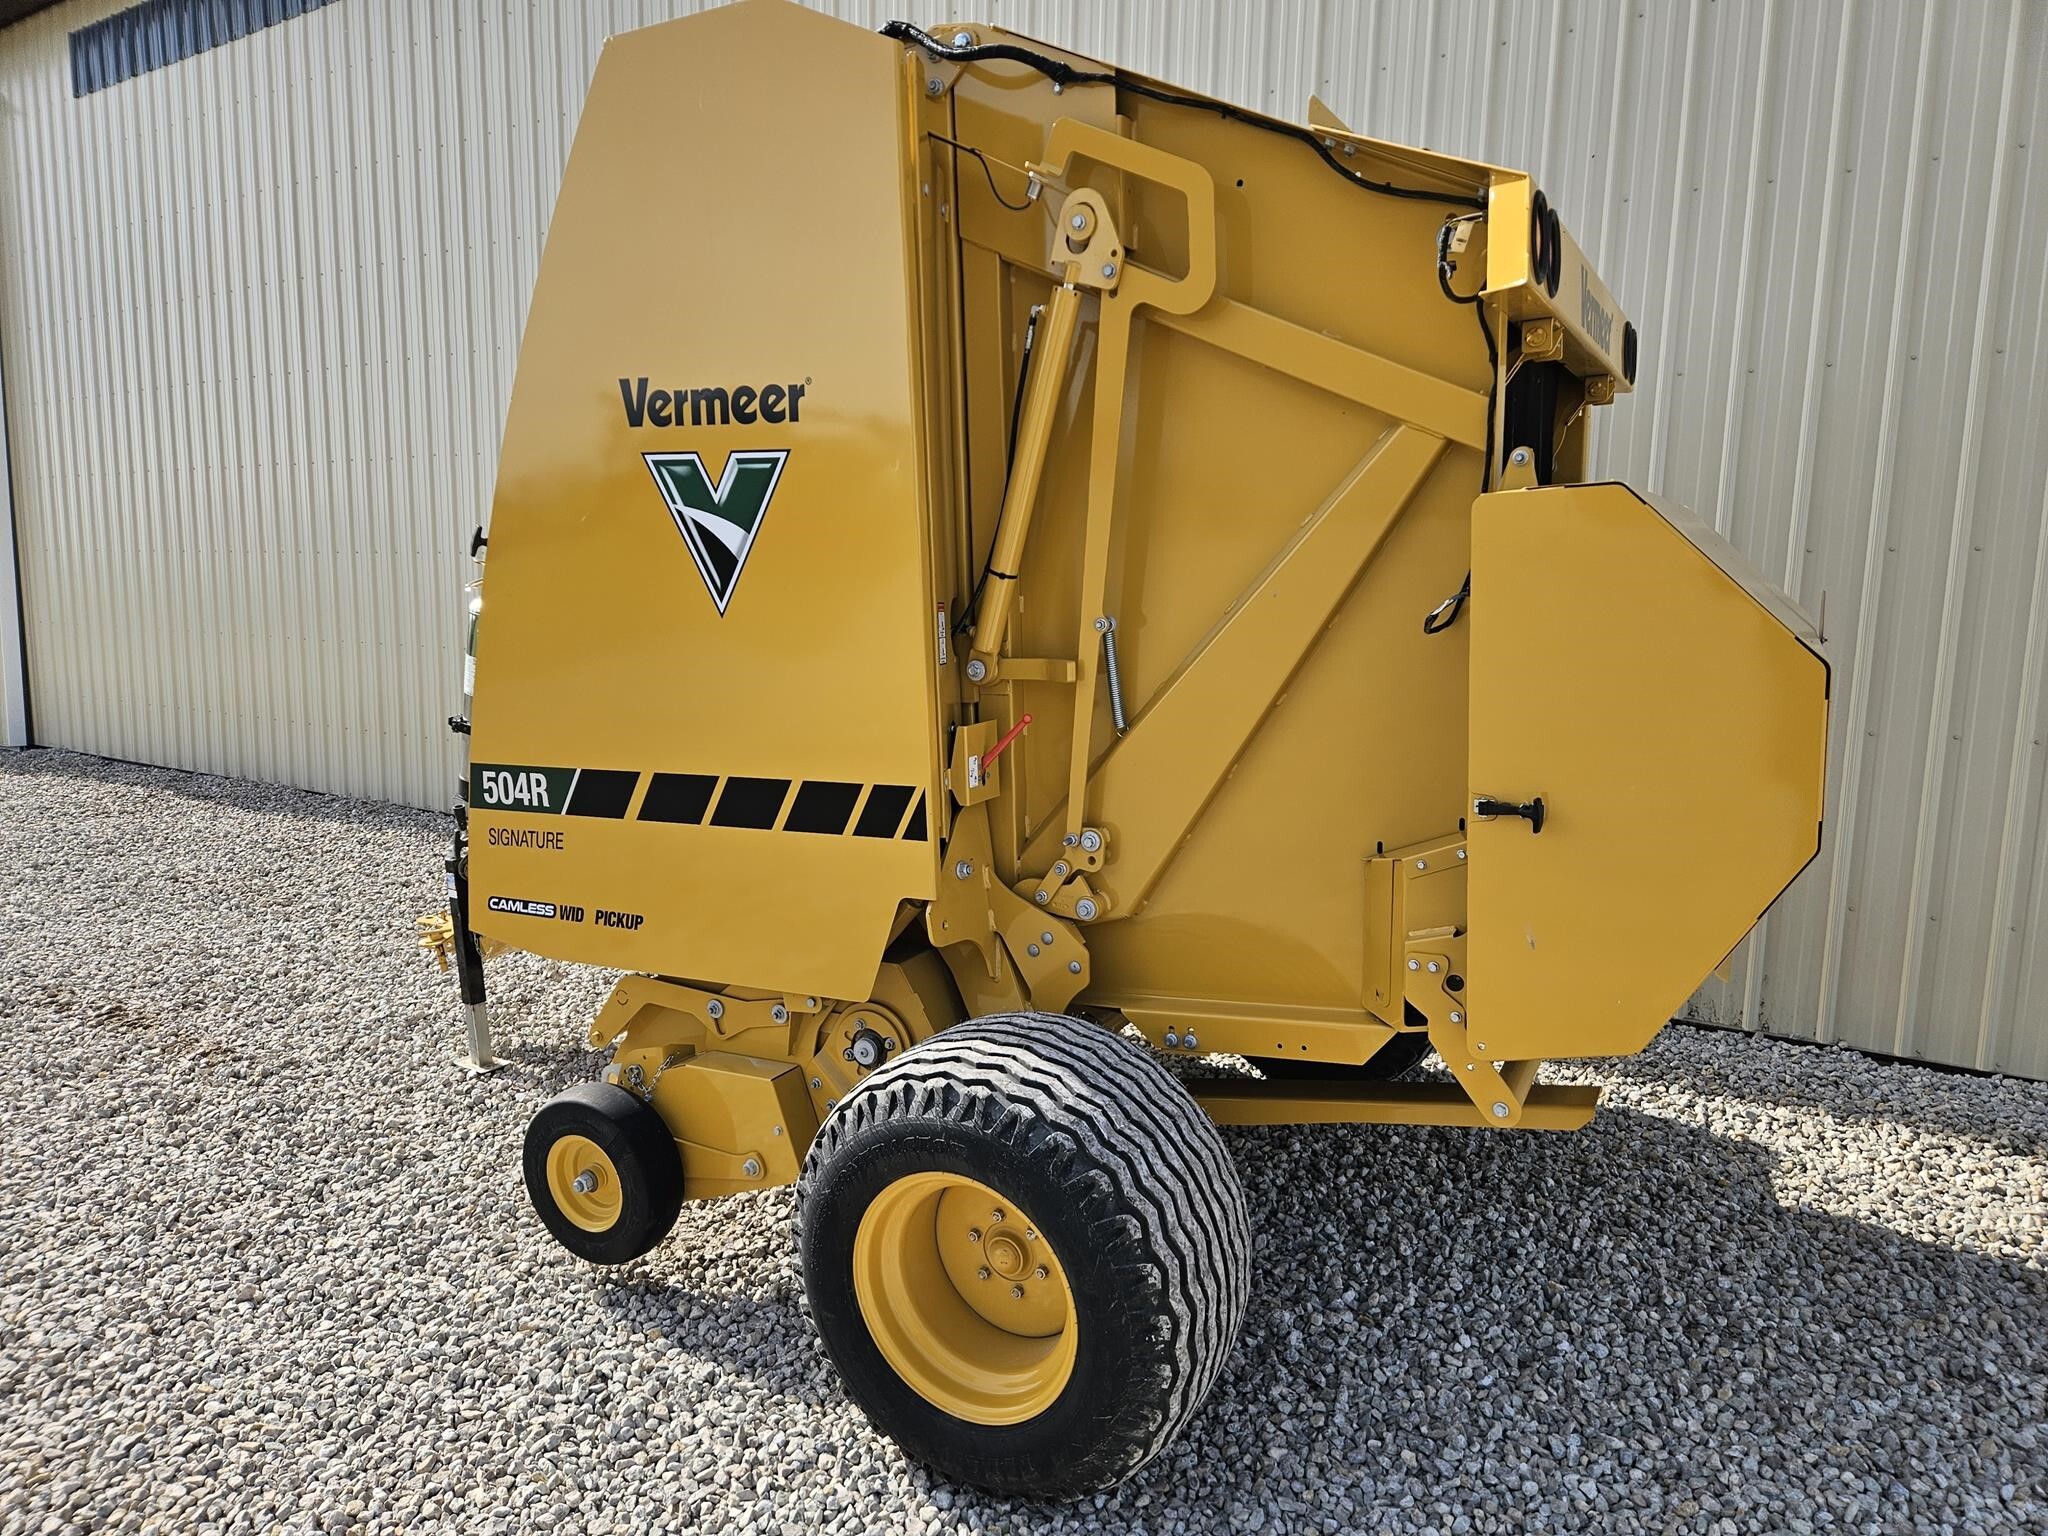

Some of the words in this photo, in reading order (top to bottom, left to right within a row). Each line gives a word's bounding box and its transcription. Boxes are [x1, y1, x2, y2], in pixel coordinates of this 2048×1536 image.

[619, 377, 805, 427] Vermeer
[482, 771, 550, 807] 504R
[488, 828, 564, 850] SIGNATURE
[489, 898, 555, 917] CAMLESS
[560, 905, 585, 923] WID
[595, 910, 644, 931] PICKUP
